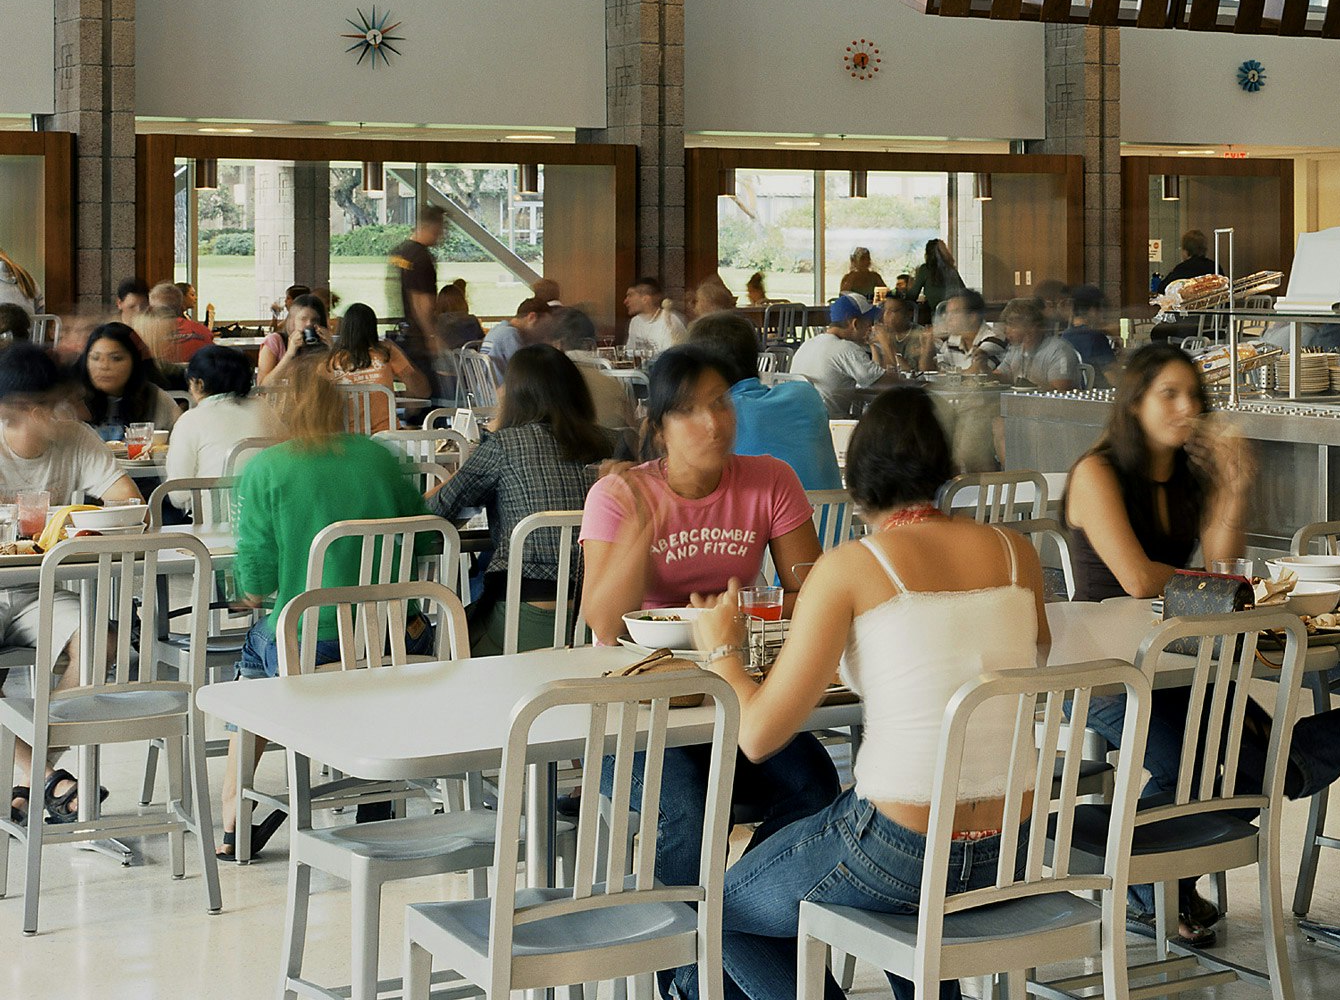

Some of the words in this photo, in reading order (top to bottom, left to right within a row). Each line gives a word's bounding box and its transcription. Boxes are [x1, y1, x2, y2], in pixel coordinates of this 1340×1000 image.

[650, 528, 757, 555] ABERCROMBIE
[665, 544, 698, 564] AND
[703, 541, 748, 557] FITCH
